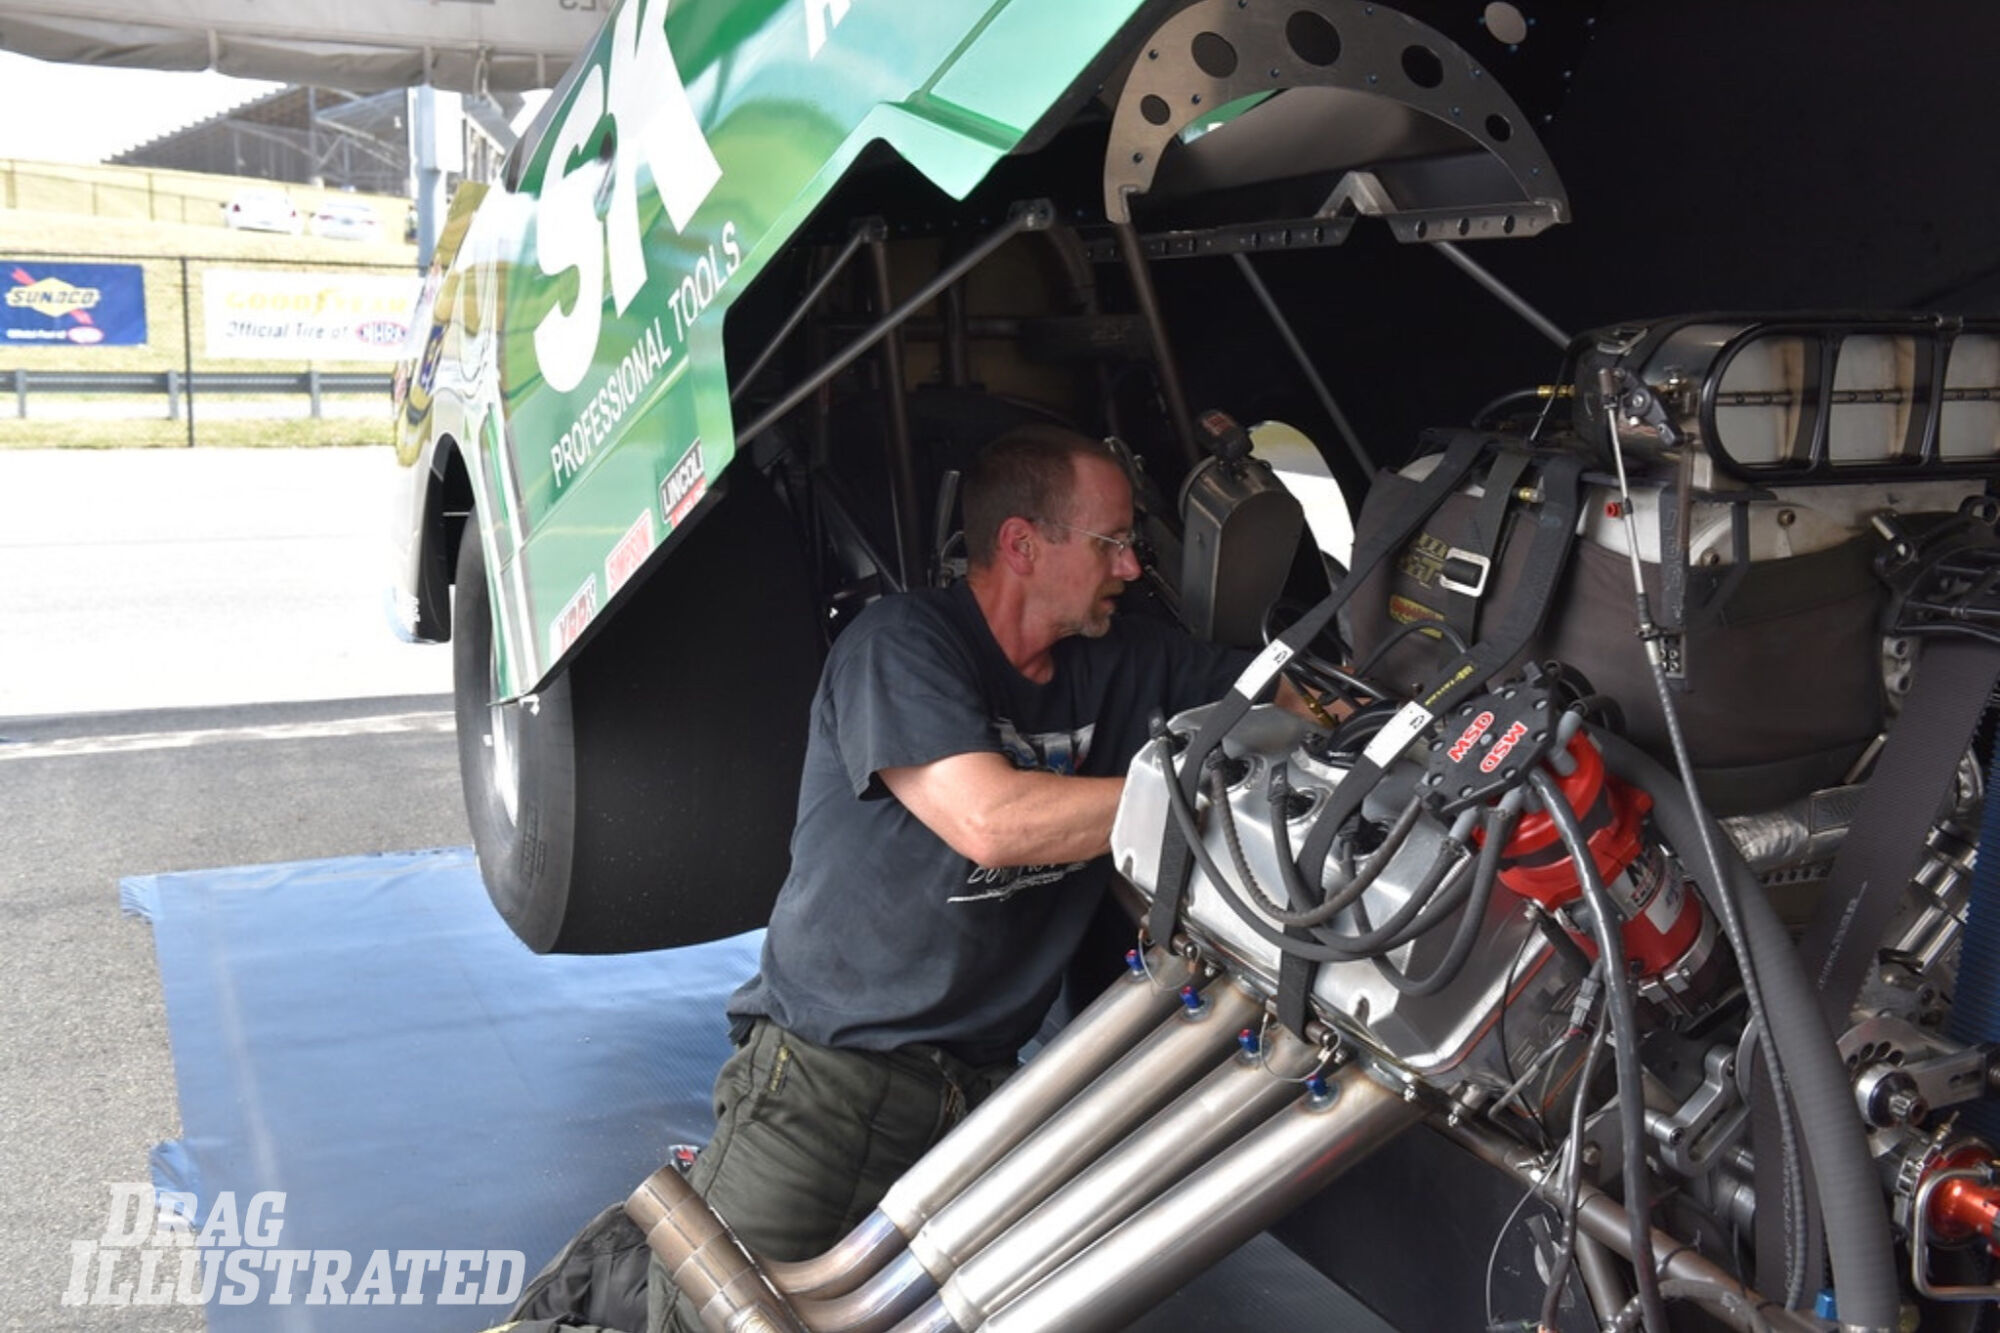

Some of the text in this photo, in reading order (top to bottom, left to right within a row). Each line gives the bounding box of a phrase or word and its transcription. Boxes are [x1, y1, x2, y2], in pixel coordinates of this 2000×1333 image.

[12, 290, 96, 304] SUNOCO
[226, 320, 290, 338] Official
[550, 220, 741, 488] PROFESSIONAL TOOLS
[1447, 711, 1494, 762] MSD
[1480, 721, 1528, 773] MSD
